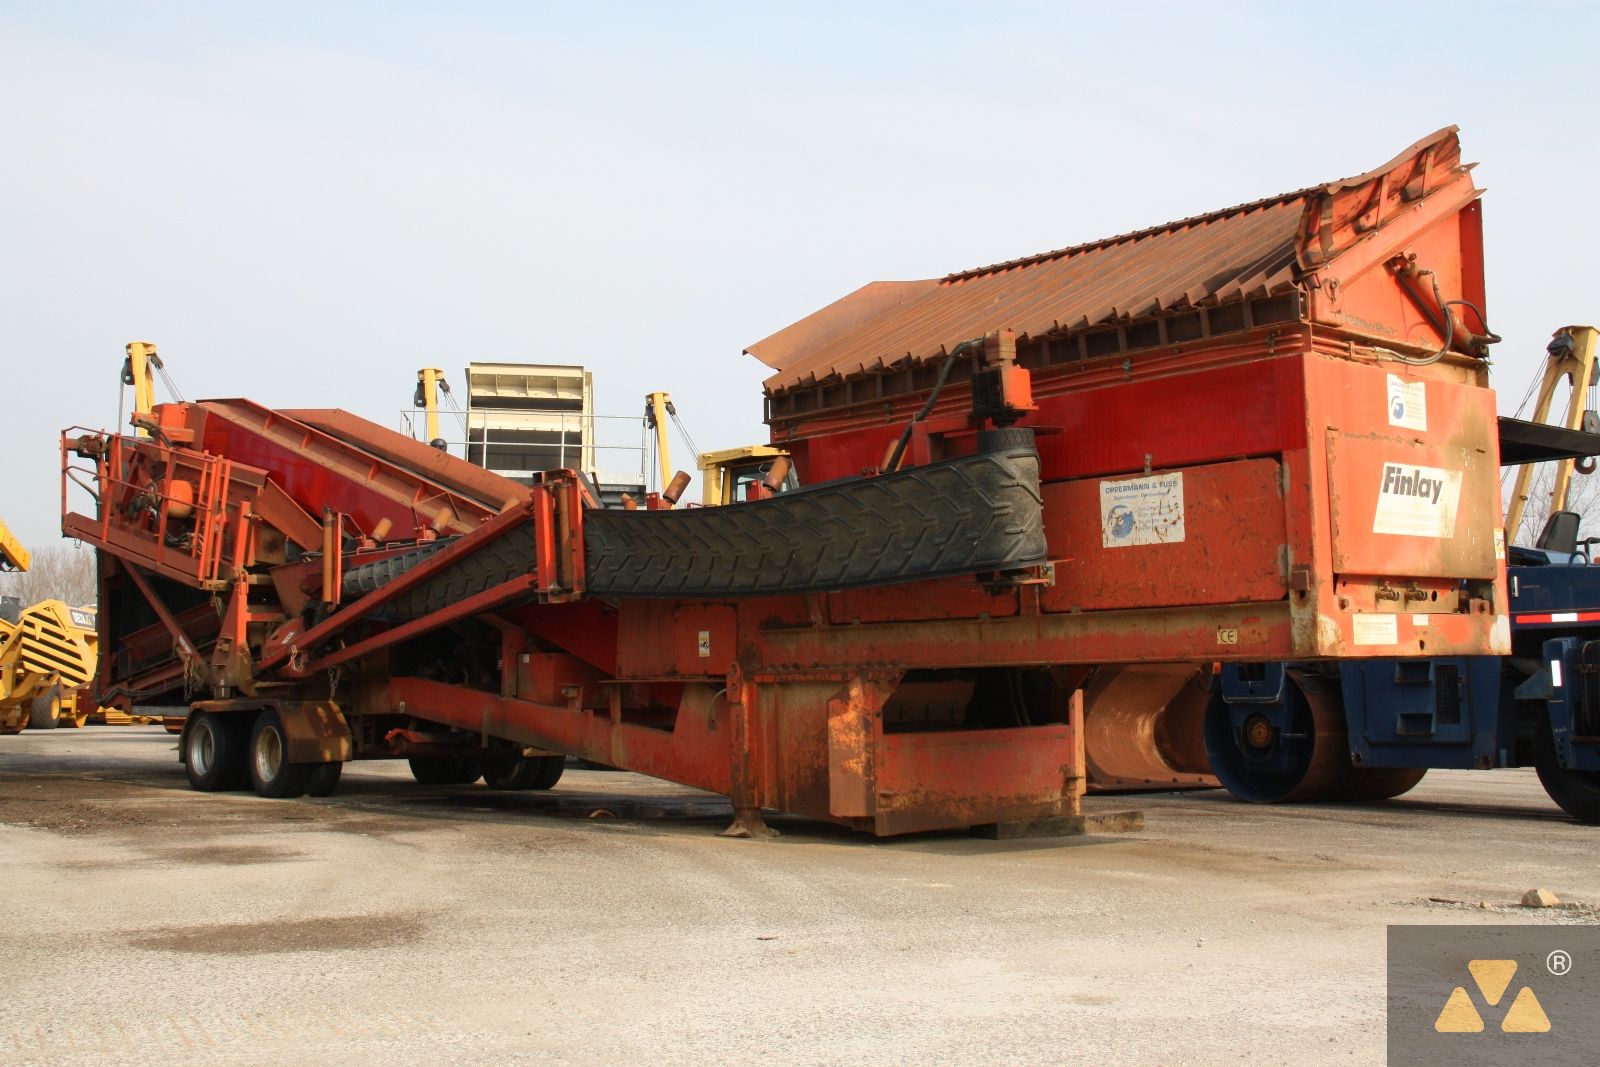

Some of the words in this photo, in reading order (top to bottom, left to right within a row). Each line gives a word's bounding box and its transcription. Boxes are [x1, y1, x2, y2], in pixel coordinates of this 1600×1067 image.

[1105, 483, 1150, 494] OPPERMANN
[1160, 480, 1178, 488] FUSS
[1383, 466, 1443, 505] Finlay
[1220, 630, 1234, 643] CE
